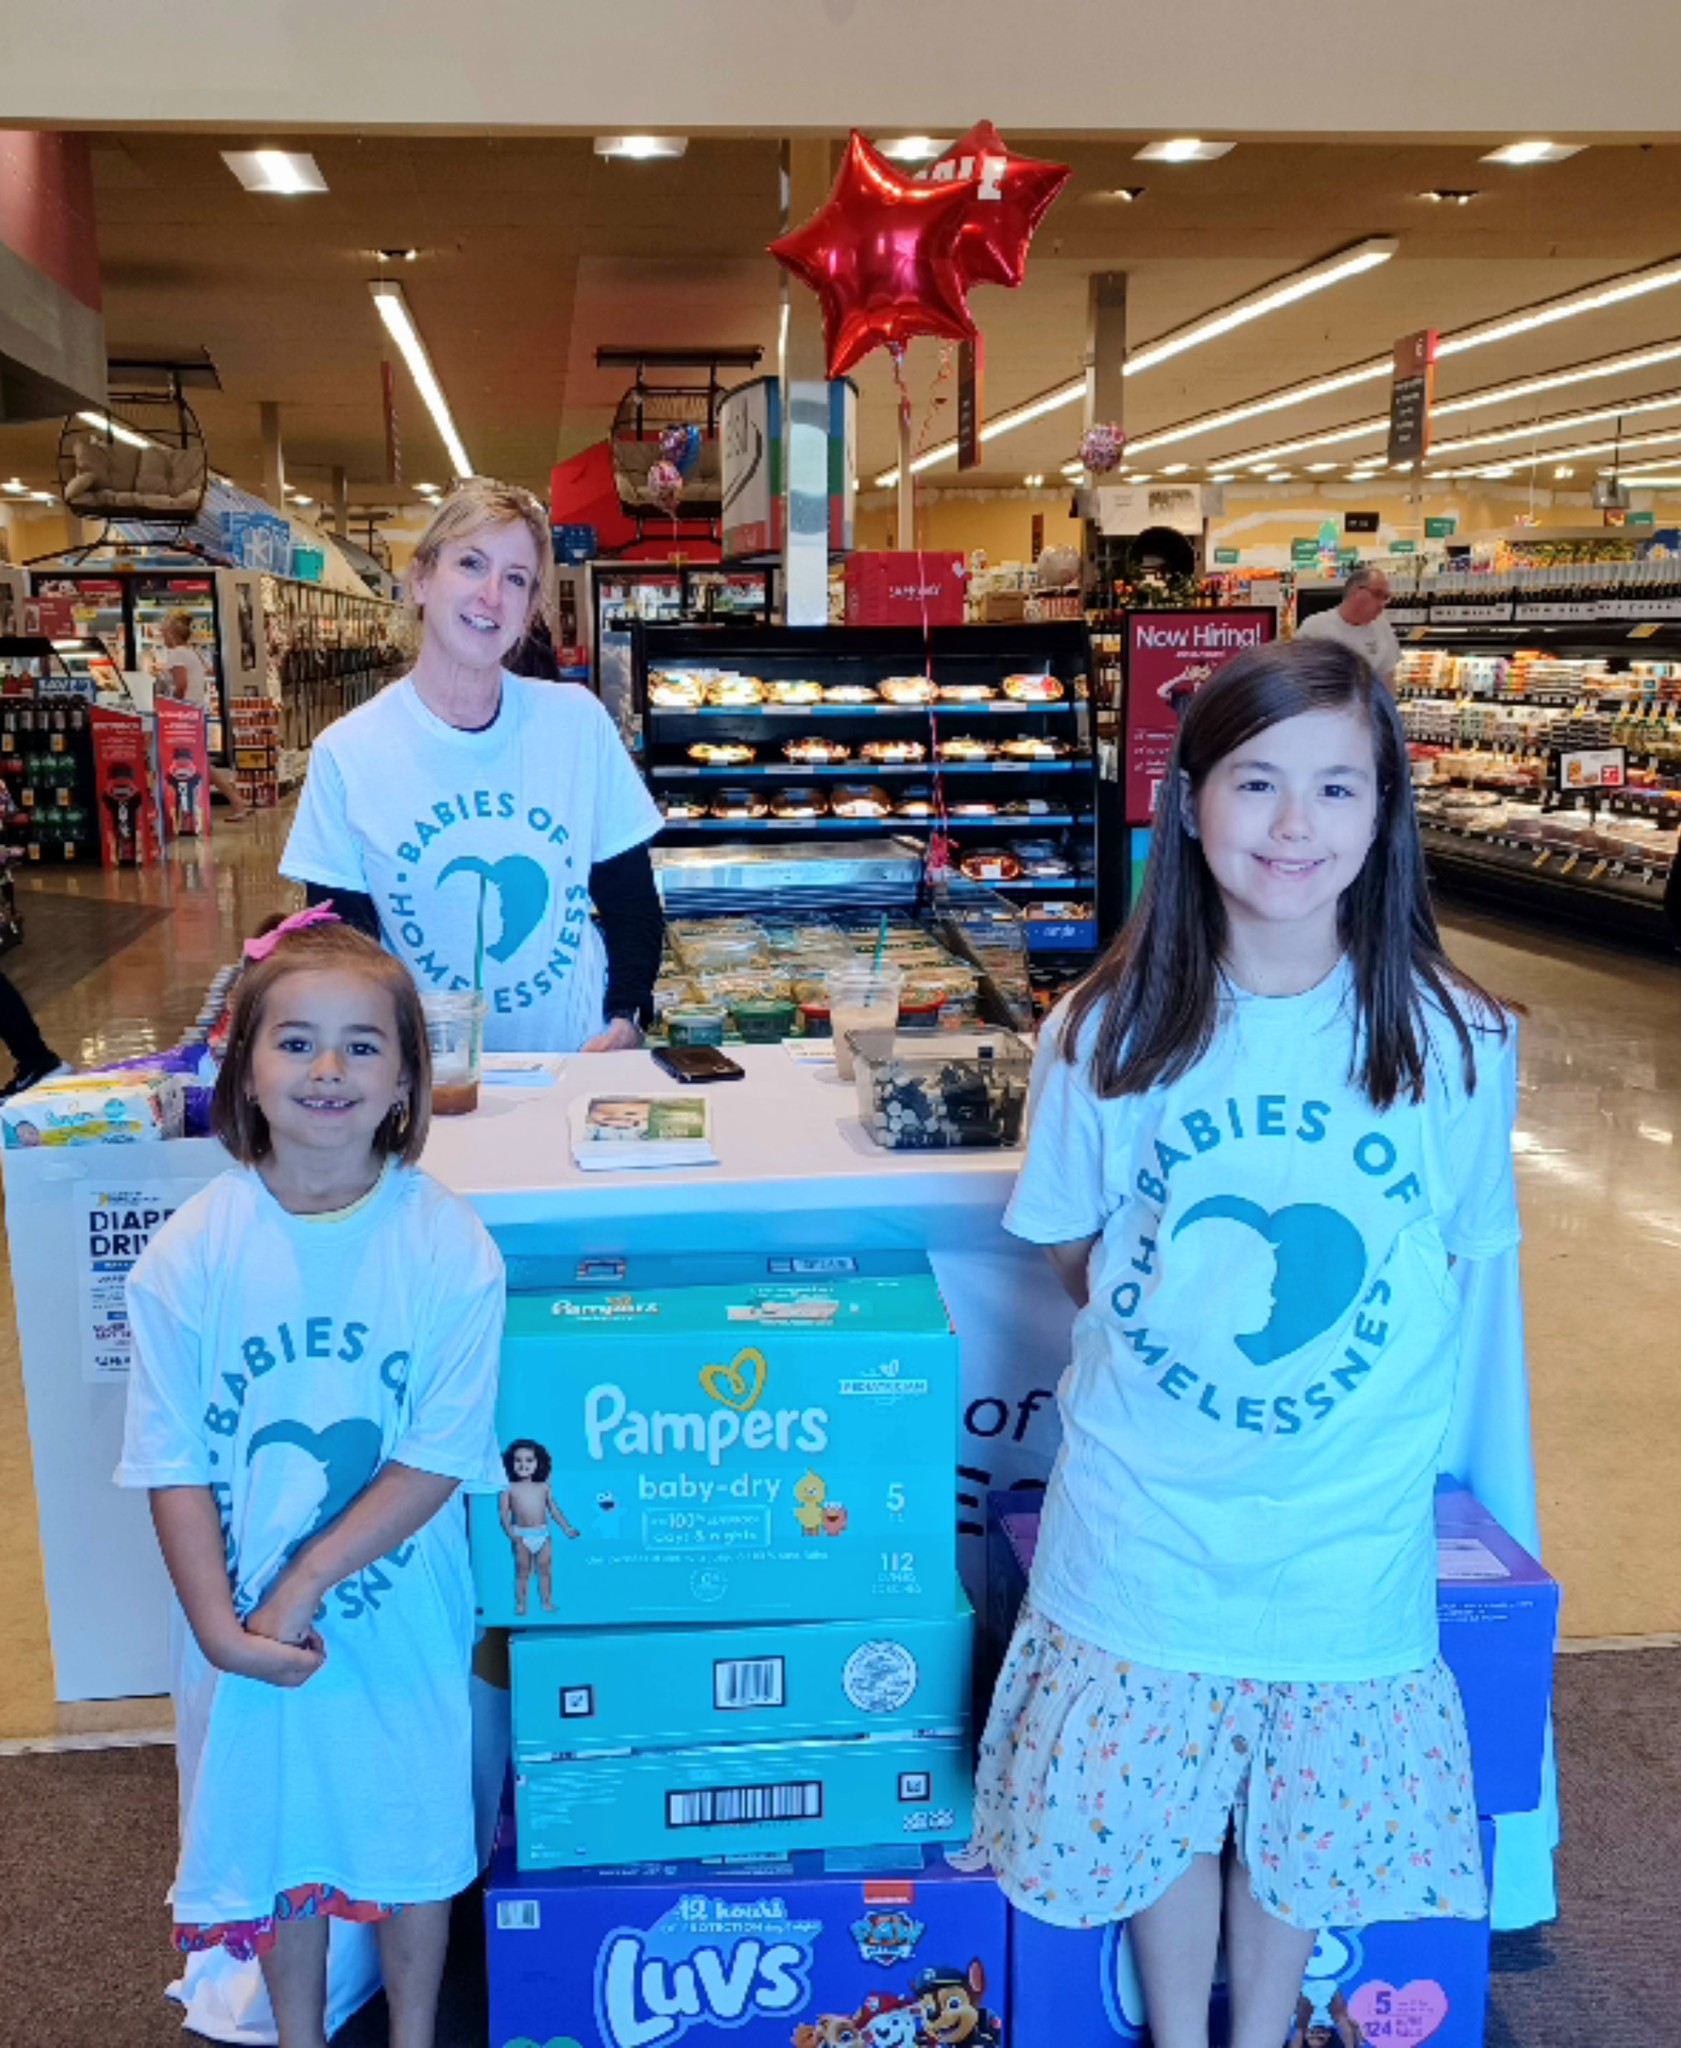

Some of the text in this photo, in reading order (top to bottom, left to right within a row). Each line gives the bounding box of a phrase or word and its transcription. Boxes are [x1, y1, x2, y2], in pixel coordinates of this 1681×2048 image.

[1136, 622, 1262, 650] Now Hiring!
[397, 790, 570, 864] BABIES OF
[1137, 1094, 1421, 1204] BABIES OF
[1111, 1236, 1393, 1435] HOMELESSNES
[204, 1316, 369, 1437] BABIES
[584, 1383, 829, 1467] Pampers
[964, 1388, 1053, 1442] of
[638, 1473, 782, 1502] baby-dry
[886, 1484, 905, 1513] 5
[881, 1552, 915, 1572] 112
[1374, 1990, 1392, 2015] 5
[1364, 2019, 1392, 2037] 124
